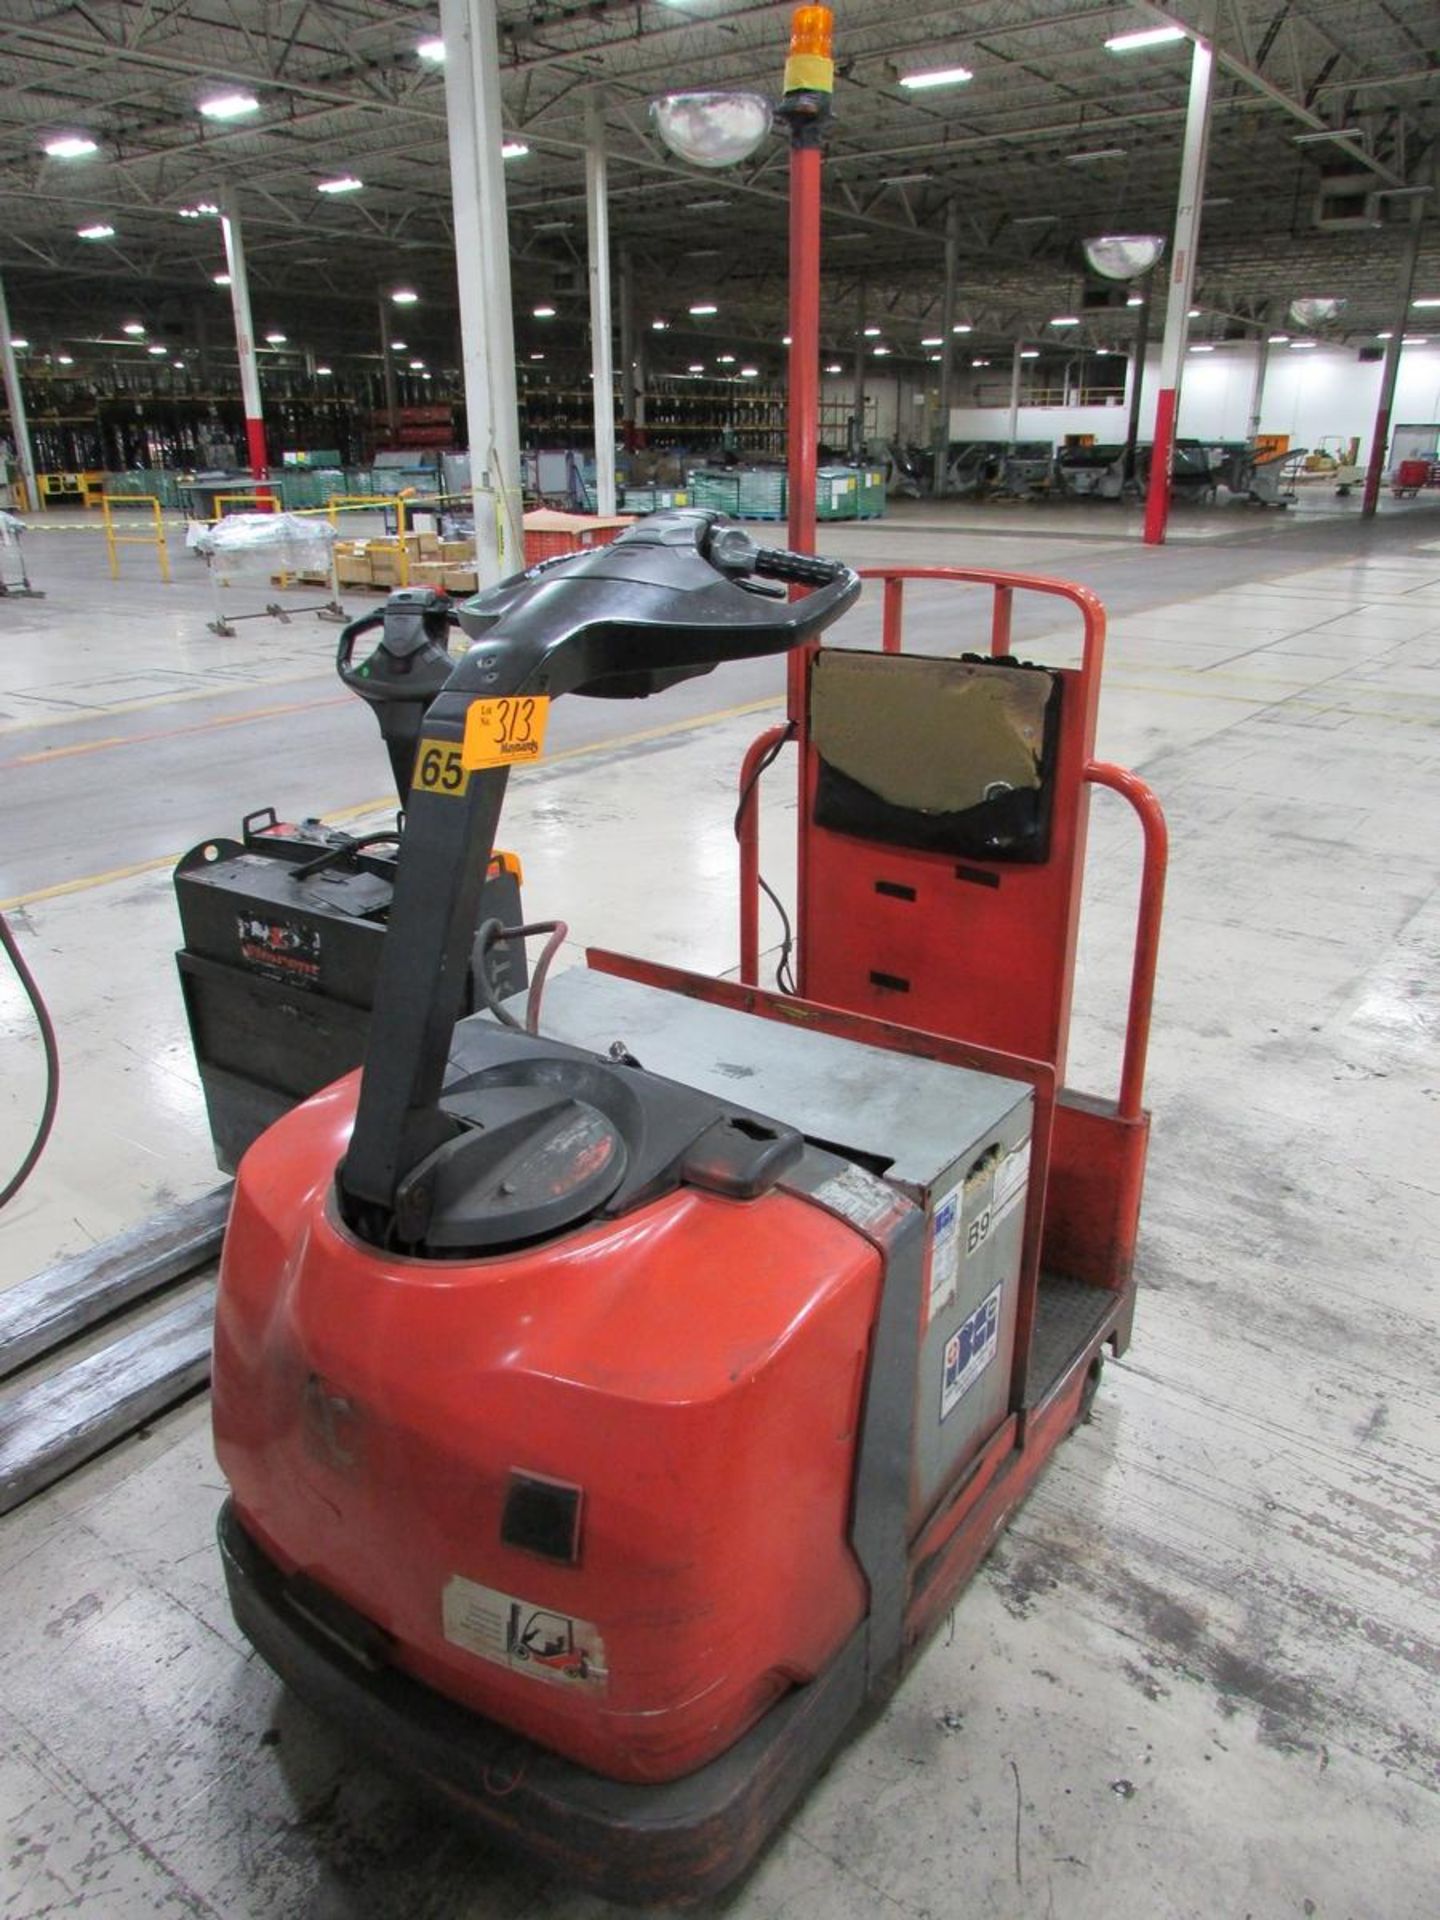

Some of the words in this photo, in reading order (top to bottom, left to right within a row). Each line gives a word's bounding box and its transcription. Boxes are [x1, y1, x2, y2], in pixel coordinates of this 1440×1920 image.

[494, 699, 535, 743] 313
[421, 748, 463, 789] 65
[968, 1211, 990, 1254] B9
